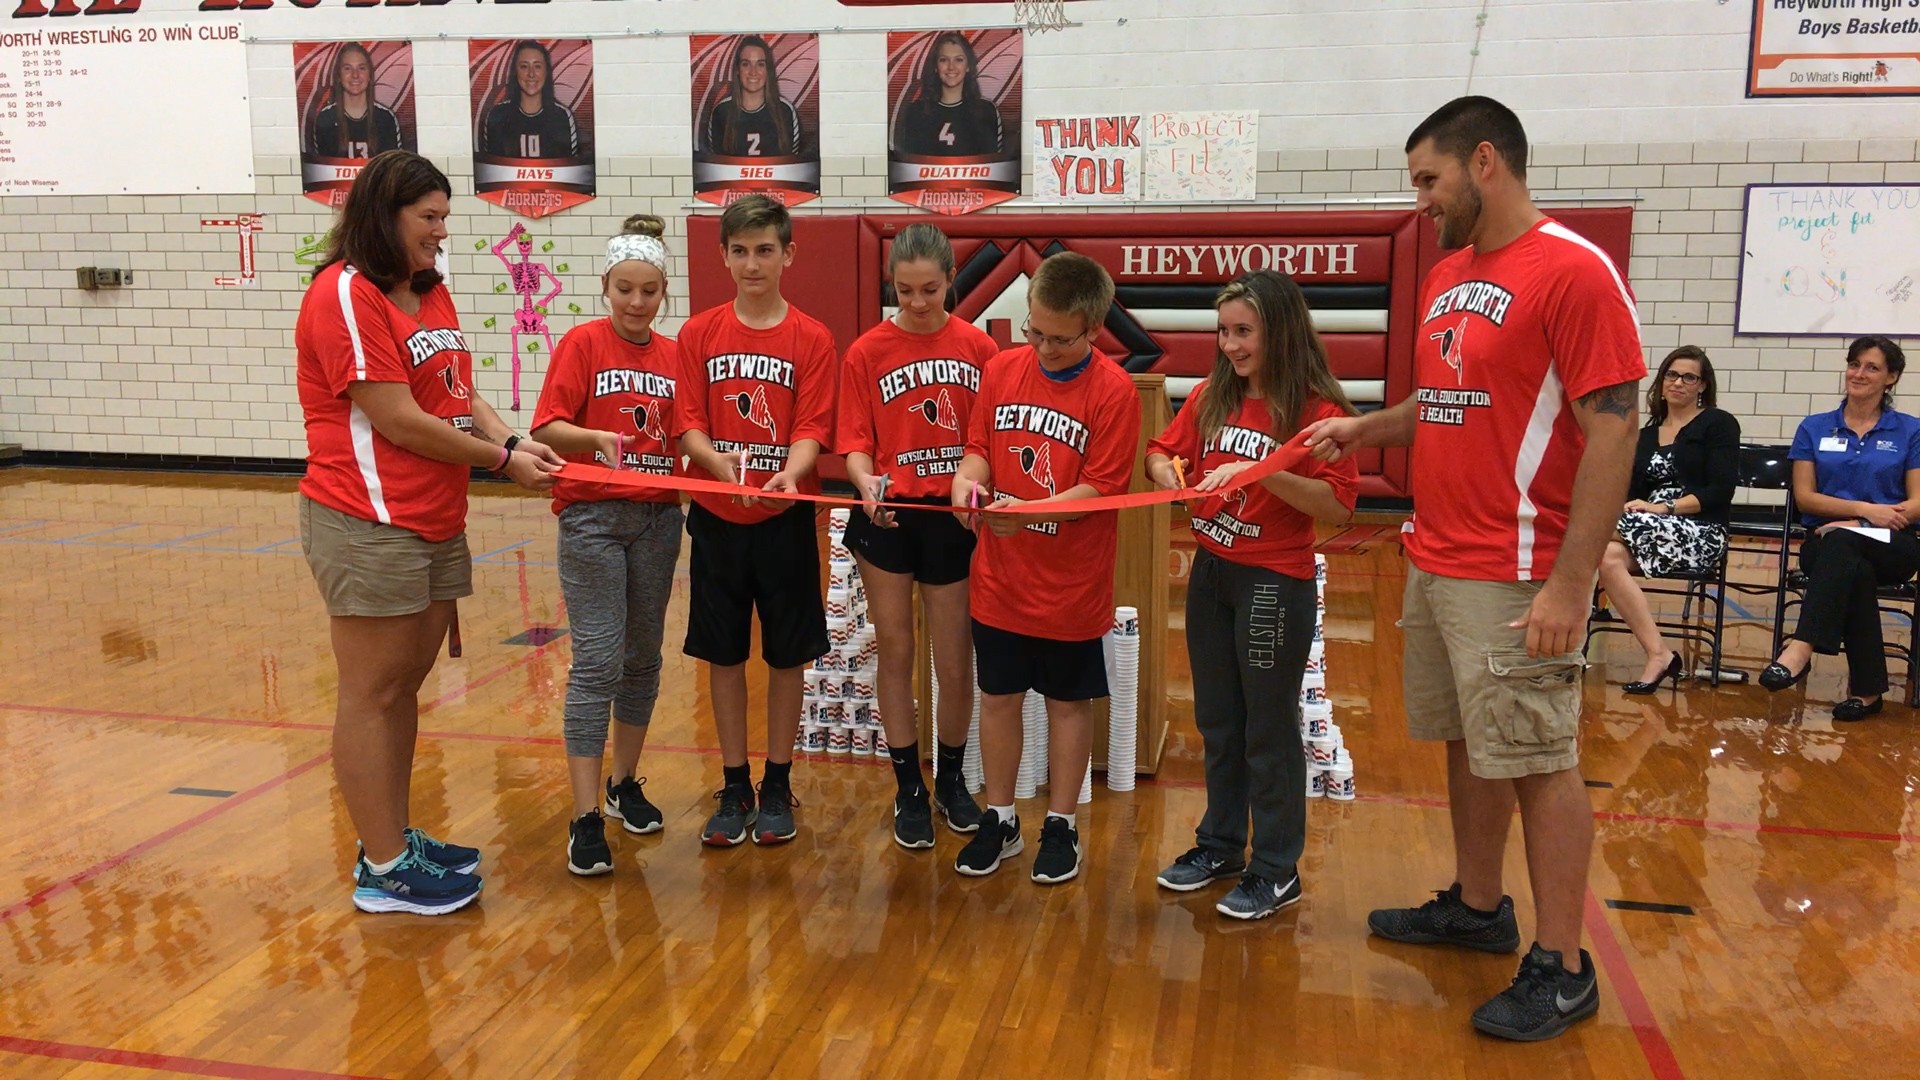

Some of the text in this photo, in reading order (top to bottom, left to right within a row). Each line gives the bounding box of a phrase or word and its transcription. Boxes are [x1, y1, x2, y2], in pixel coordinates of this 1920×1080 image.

[0, 26, 239, 48] ORTH WRESTLING 20 WIN CLUB
[1798, 19, 1841, 38] Boys
[1790, 72, 1873, 83] Do What's Right!
[938, 123, 955, 145] 4
[1036, 116, 1140, 151] THANK
[1152, 113, 1244, 139] PROJECT
[520, 134, 540, 157] 10
[747, 133, 761, 155] 2
[516, 168, 553, 179] HAYS
[740, 167, 773, 178] SIEG
[918, 167, 990, 178] QUATTRO
[1051, 155, 1124, 196] YOU
[507, 192, 562, 206] HORNETS
[923, 192, 984, 206] HORNETS
[1769, 190, 1856, 212] THANK
[1778, 212, 1840, 241] project
[1120, 243, 1358, 275] HEYWORTH
[1423, 281, 1512, 325] HEYWORTH
[879, 360, 981, 403] HEYWORTH
[1427, 408, 1463, 424] HEALTH
[917, 465, 926, 476] &
[1249, 583, 1280, 669] HOLLISTER
